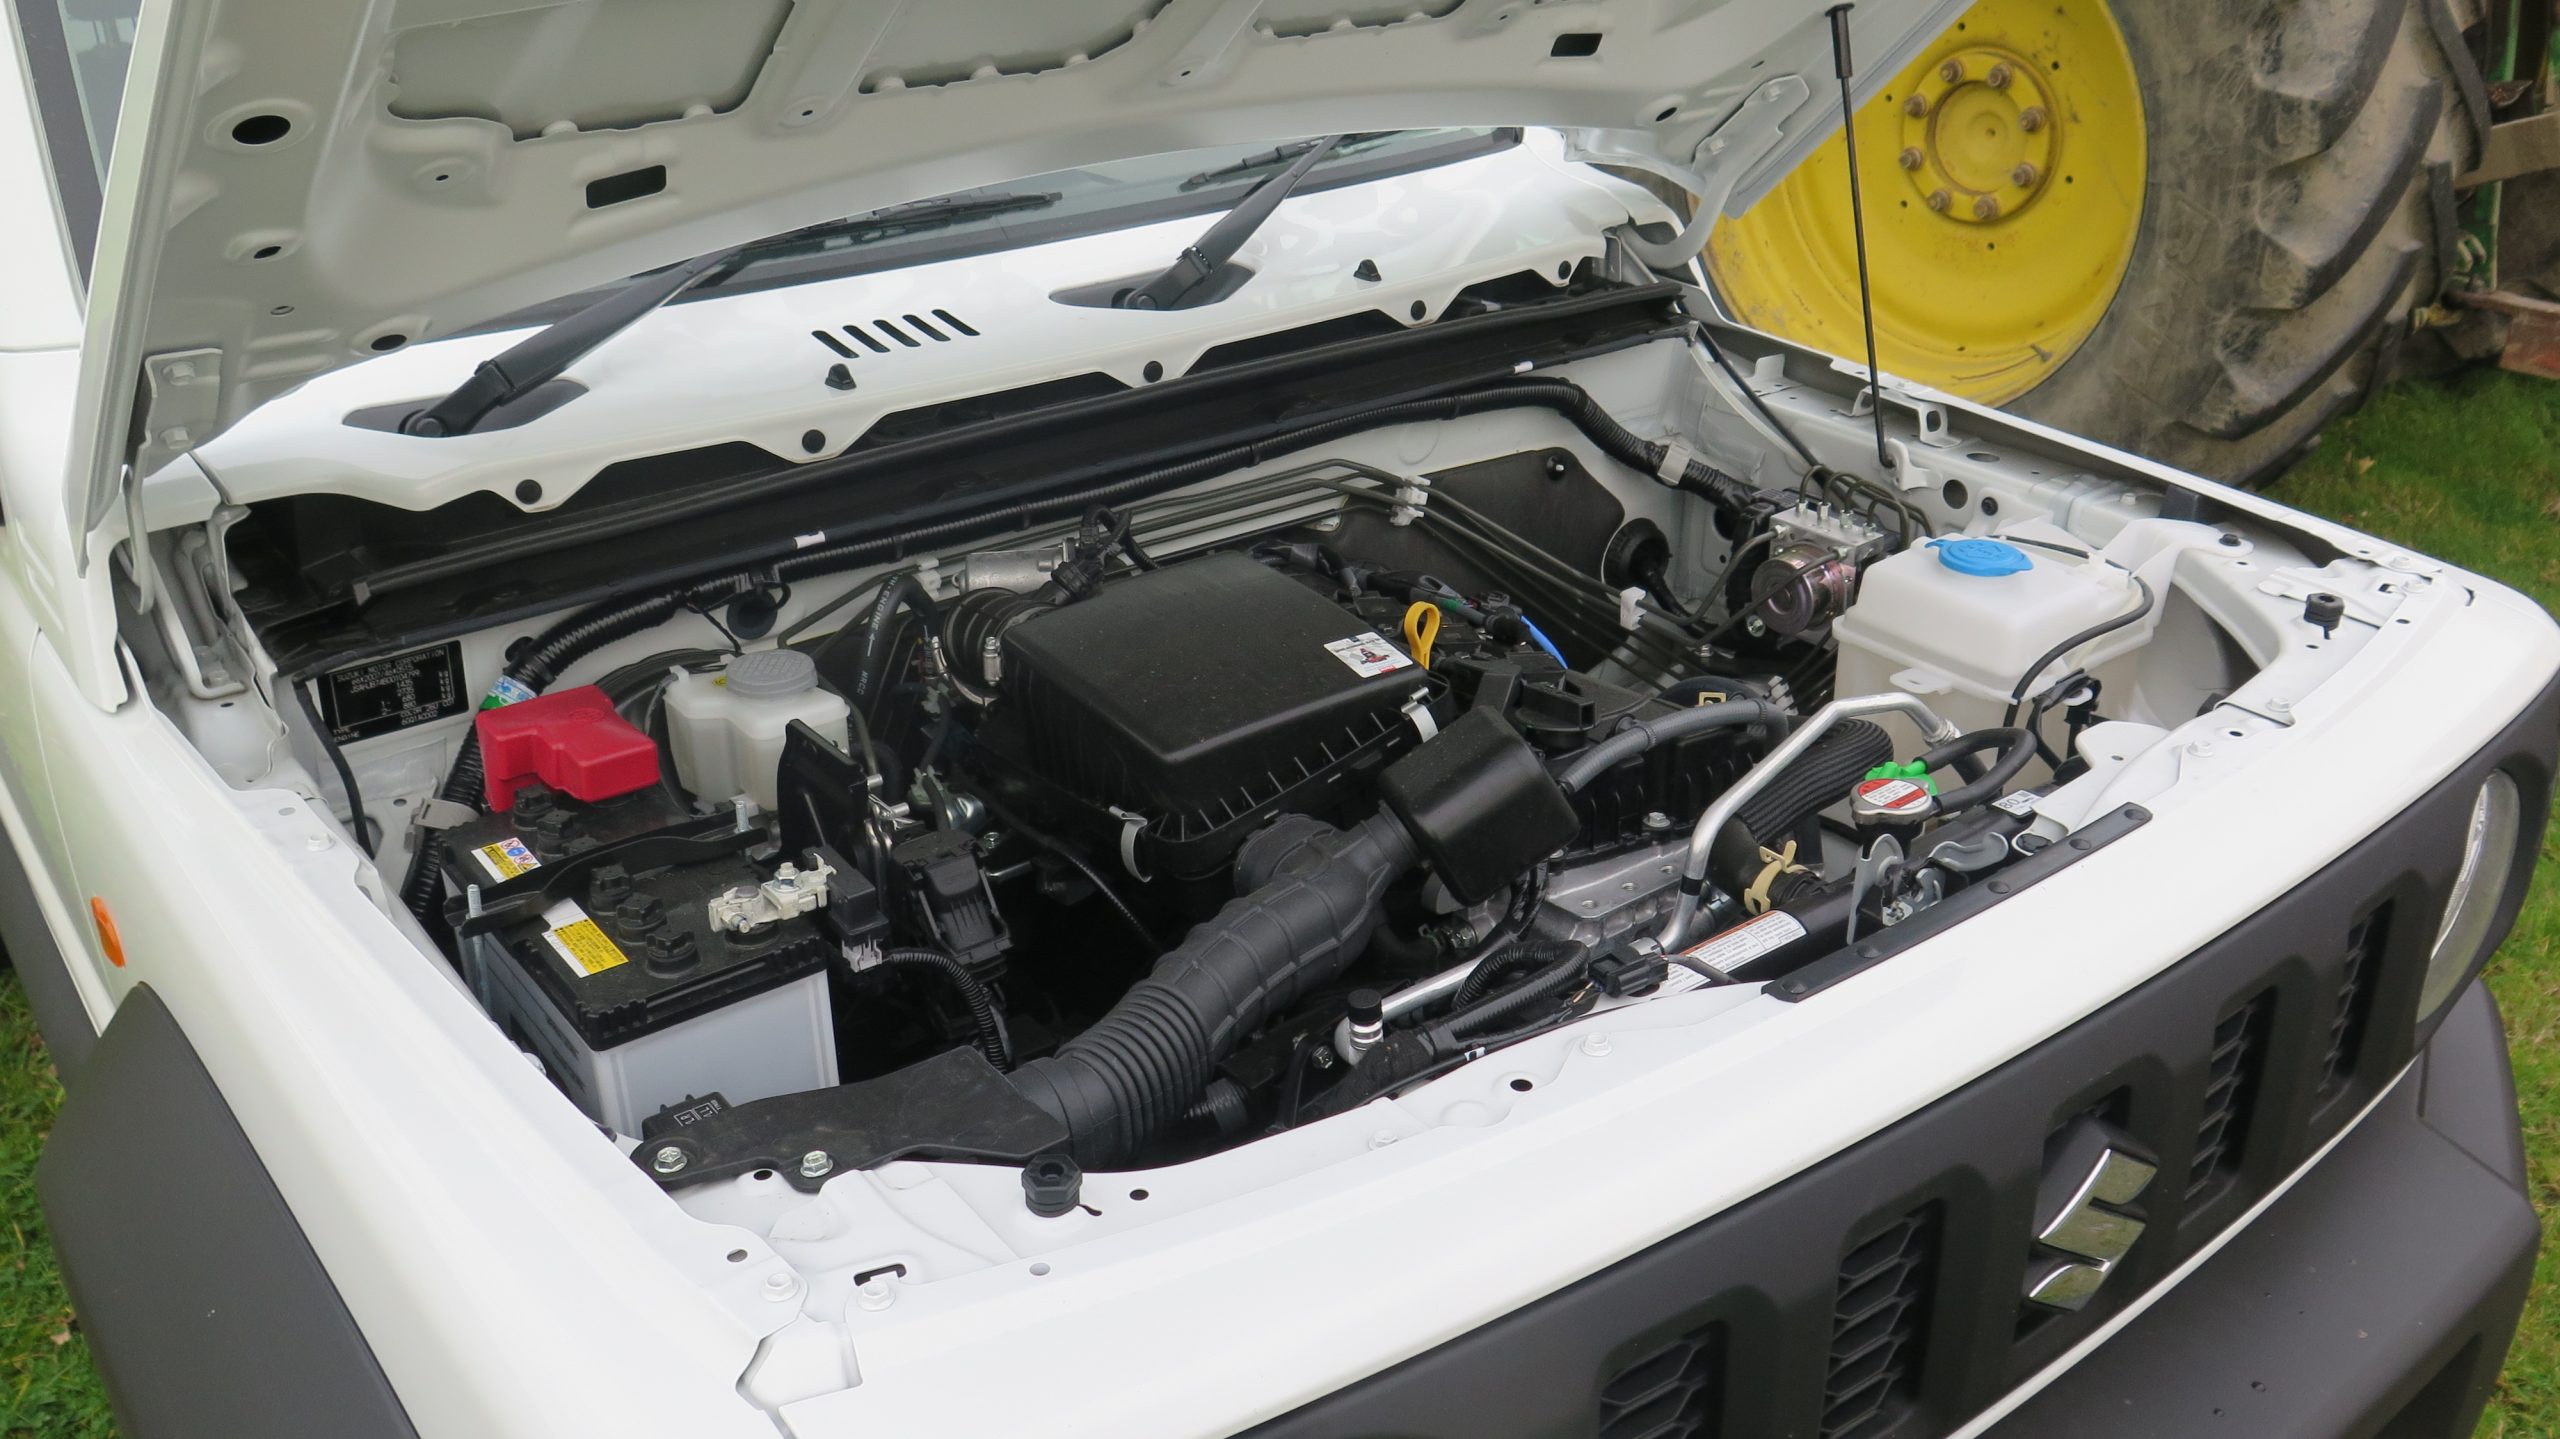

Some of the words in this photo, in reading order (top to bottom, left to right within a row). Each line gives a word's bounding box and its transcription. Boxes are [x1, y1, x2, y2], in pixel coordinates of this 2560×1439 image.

[337, 670, 363, 682] SUZUKI
[367, 662, 391, 674] MOTOR
[394, 649, 444, 667] CORPORATION
[1999, 798, 2020, 809] 80
